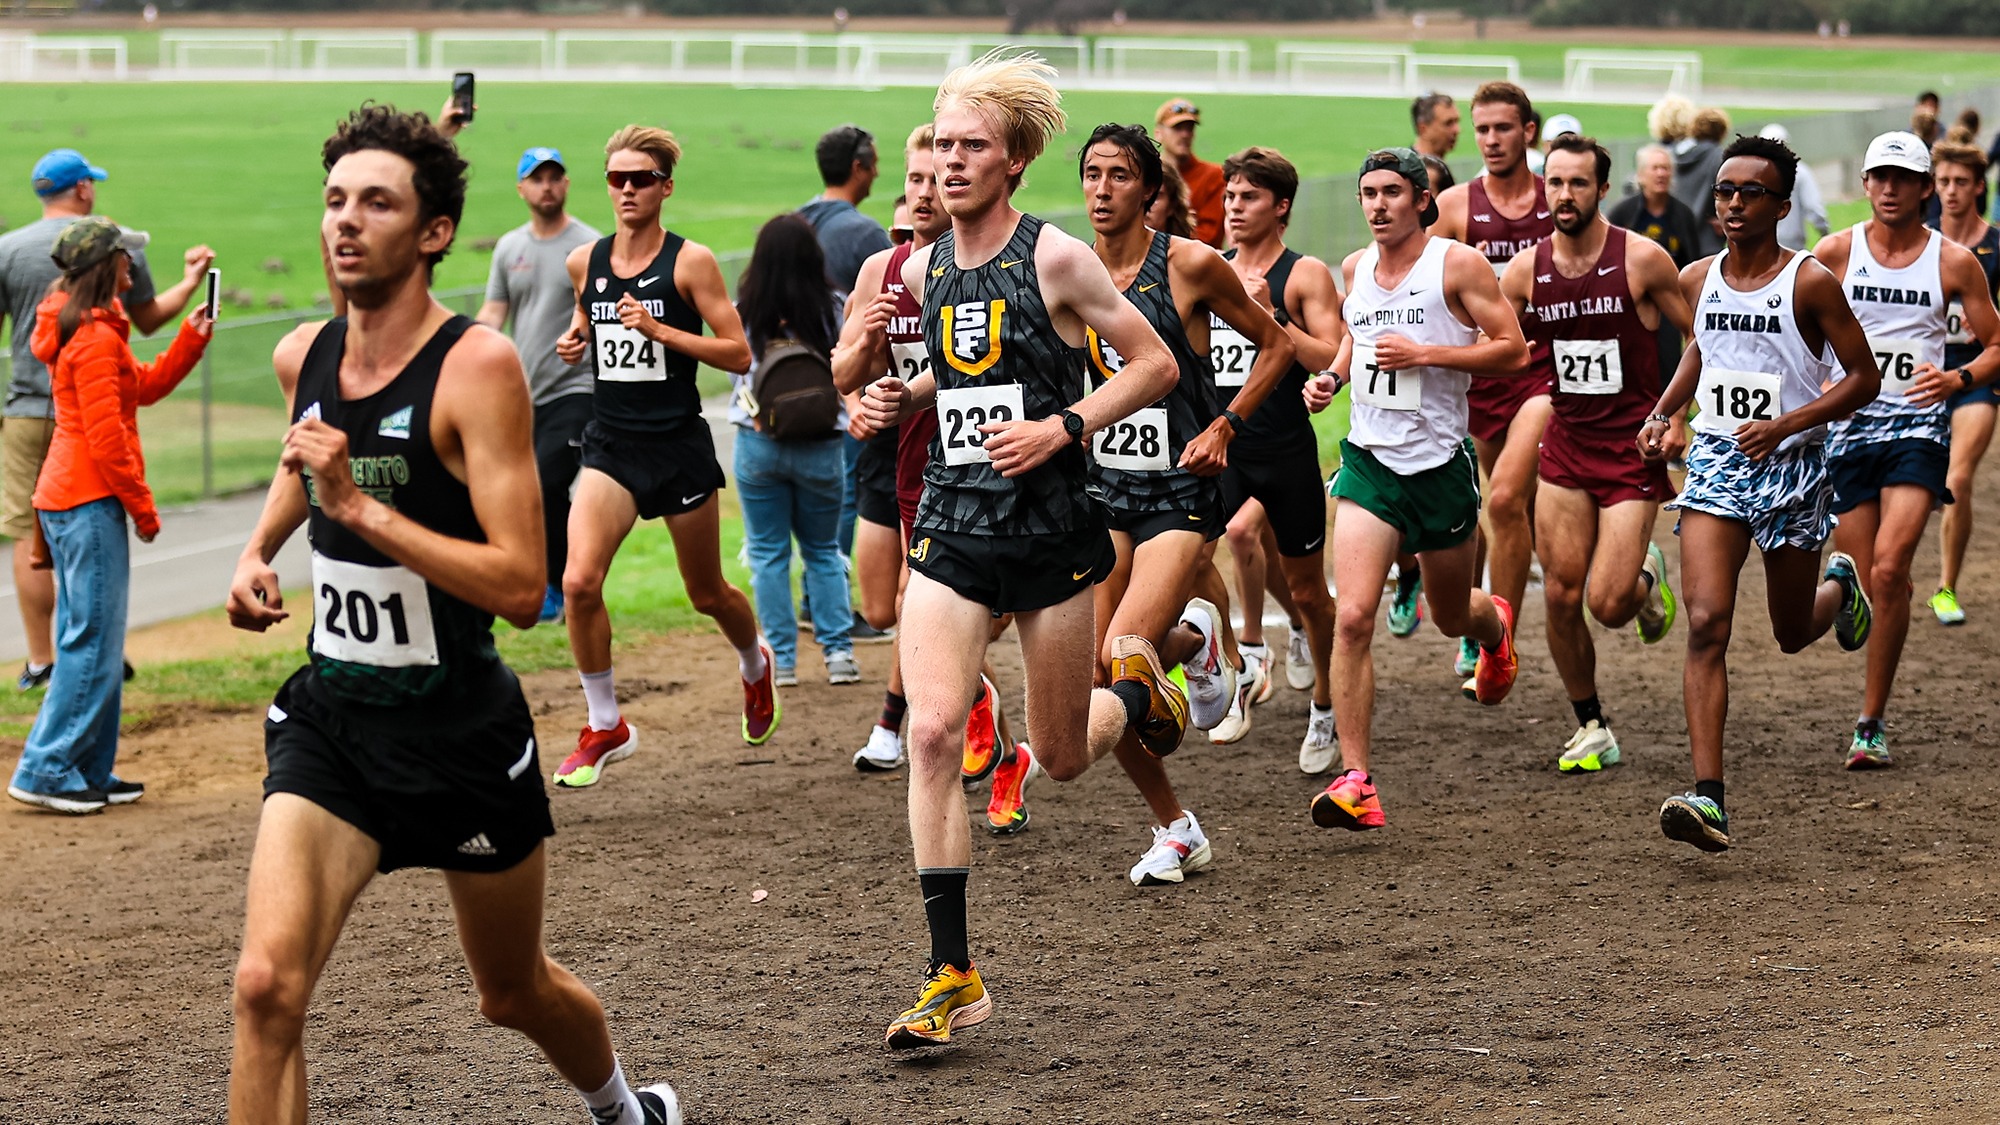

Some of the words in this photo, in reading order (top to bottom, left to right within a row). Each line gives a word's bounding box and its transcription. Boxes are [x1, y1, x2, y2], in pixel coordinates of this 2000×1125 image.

[1536, 301, 1578, 322] SANTA
[1580, 296, 1624, 315] CLARA
[1852, 285, 1931, 307] NEVADA
[1705, 312, 1782, 334] NEVADA
[603, 339, 657, 369] 324
[1561, 353, 1609, 382] 271
[1365, 363, 1397, 396] 71
[1711, 384, 1772, 421] 182
[1100, 422, 1161, 458] 228
[321, 583, 410, 645] 201
